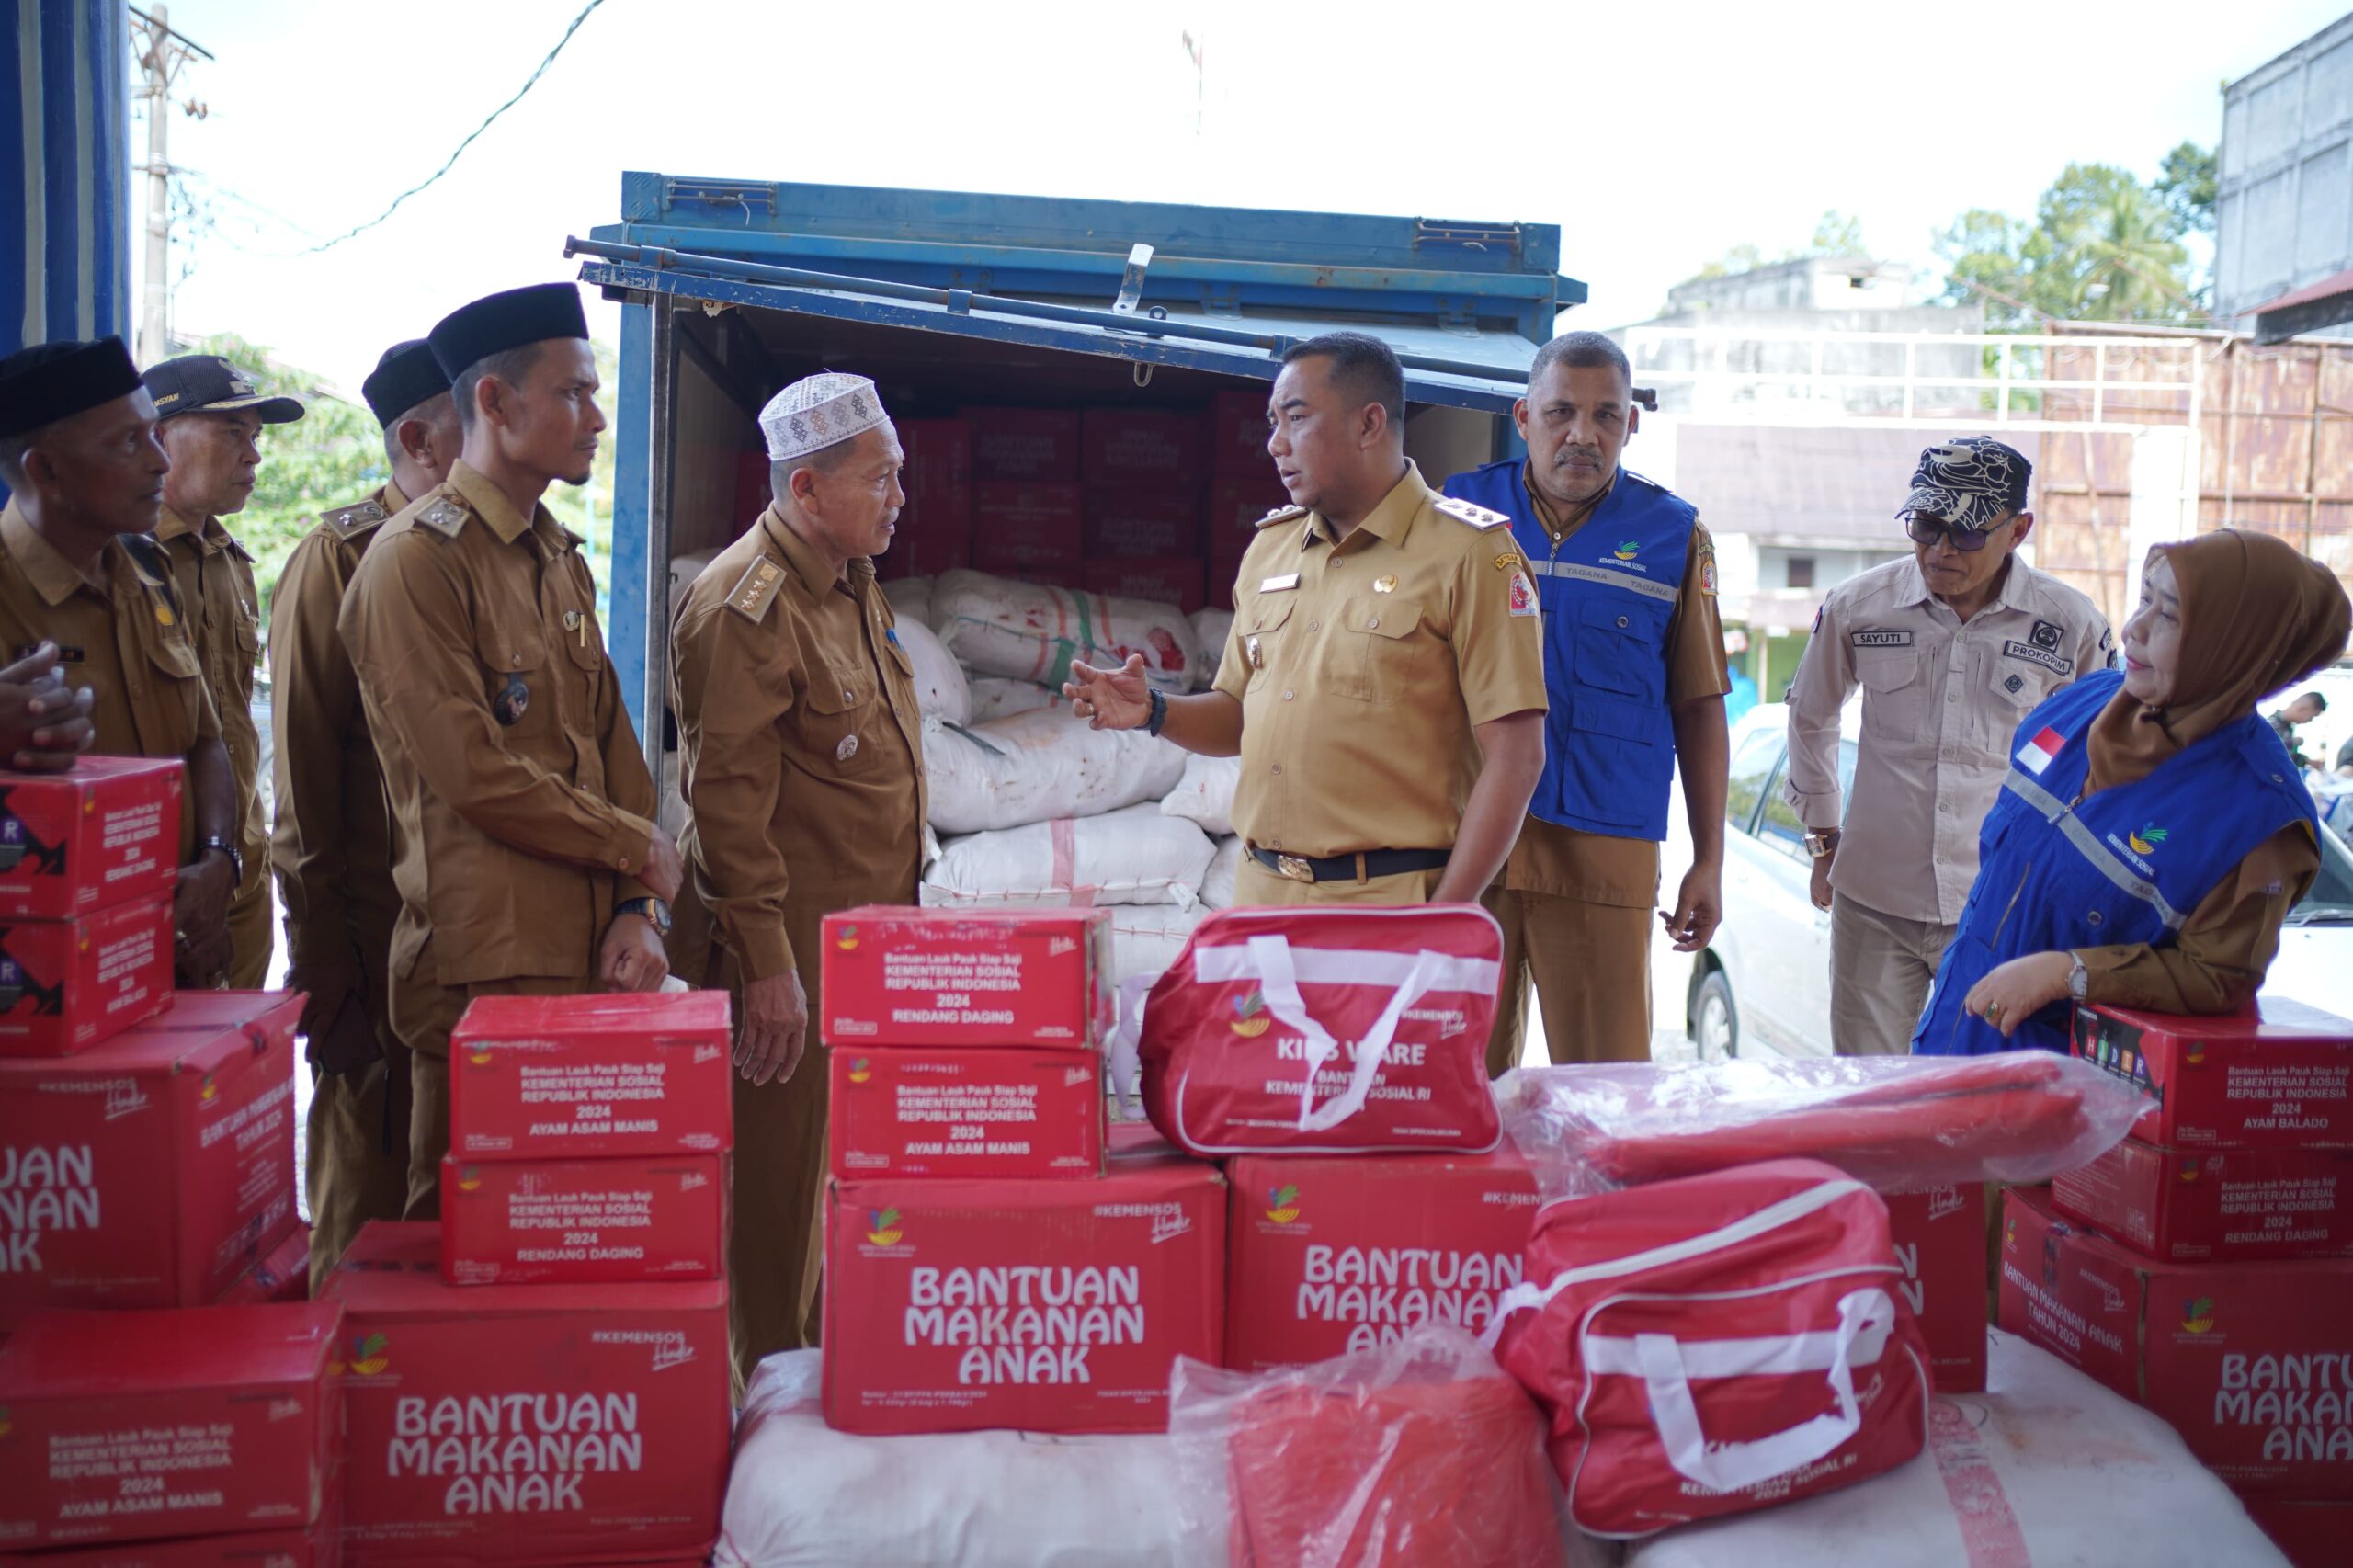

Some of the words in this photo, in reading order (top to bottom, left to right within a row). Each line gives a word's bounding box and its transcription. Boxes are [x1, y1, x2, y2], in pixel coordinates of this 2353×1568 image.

[1632, 563, 1647, 573] SOSIAL
[1566, 567, 1608, 581] TAGANA
[1631, 580, 1668, 597] TAGANA
[1860, 633, 1901, 644] SAYUTI
[2013, 645, 2066, 673] PROKOPIM
[2130, 880, 2170, 919] TAGANA
[885, 966, 973, 977] KEMENTERIAN
[976, 966, 1021, 977] SOSIAL
[885, 978, 949, 990] REPUBLIK
[951, 978, 1021, 990] INDONESIA
[937, 994, 971, 1007] 2024
[892, 1010, 959, 1023] RENDANG
[961, 1010, 1015, 1023] DAGING
[1277, 1038, 1339, 1061] KIS
[1317, 1070, 1386, 1085] BANTN
[2228, 1066, 2263, 1075] Bantuan
[2266, 1066, 2288, 1075] Lauk
[2290, 1066, 2311, 1075] Pauk
[2313, 1066, 2332, 1077] Siap
[2334, 1066, 2350, 1076] Saji
[521, 1077, 615, 1089] KEMENTERIAN
[618, 1075, 664, 1086] SOSIAL
[2228, 1076, 2306, 1087] KEMENTERIAN
[2309, 1076, 2348, 1087] SOSIAL
[521, 1089, 588, 1102] REPUBLIK
[592, 1088, 664, 1100] INDONESIA
[1265, 1081, 1347, 1098] KEMETERI
[1369, 1085, 1415, 1100] SOSIAL
[1417, 1088, 1431, 1100] RI
[2227, 1088, 2281, 1099] REPUBLIK
[2285, 1087, 2347, 1098] INDONESIA
[897, 1097, 987, 1109] KEMENTERIAN
[991, 1097, 1037, 1109] SOSIAL
[2272, 1103, 2301, 1114] 2024
[576, 1106, 611, 1119] 2024
[897, 1109, 963, 1122] REPUBLIK
[965, 1109, 1037, 1122] INDONESIA
[530, 1123, 568, 1136] AYAM
[571, 1121, 609, 1134] ASAM
[614, 1120, 658, 1132] MANIS
[2244, 1118, 2276, 1129] AYAM
[2279, 1118, 2329, 1128] BALADO
[950, 1126, 984, 1140] 2024
[905, 1142, 943, 1155] AYAM
[945, 1142, 984, 1155] ASAM
[987, 1142, 1030, 1155] MANIS
[2222, 1182, 2254, 1191] Bantuan
[2256, 1181, 2280, 1190] Lauk
[2282, 1180, 2304, 1189] Pauk
[2306, 1179, 2323, 1189] Siap
[2324, 1177, 2336, 1187] Saji
[2222, 1191, 2297, 1202] KEMENTERIAN
[2300, 1189, 2336, 1199] SOSIAL
[509, 1205, 601, 1216] KEMENTERIAN
[605, 1204, 651, 1214] SOSIAL
[1093, 1202, 1183, 1218] #KEMENSOS
[2222, 1202, 2273, 1213] REPUBLIK
[2277, 1200, 2335, 1212] INDONESIA
[510, 1217, 576, 1228] REPUBLIK
[579, 1215, 651, 1227] INDONESIA
[2265, 1217, 2292, 1228] 2024
[563, 1233, 598, 1244] 2024
[2225, 1233, 2281, 1243] RENDANG
[2285, 1229, 2328, 1240] DAGING
[517, 1248, 586, 1261] RENDANG
[589, 1247, 644, 1260] DAGING
[1304, 1244, 1523, 1290] BANTUAN
[910, 1265, 1139, 1307] BANTUAN
[1297, 1282, 1515, 1328] MAKANA
[2004, 1261, 2039, 1300] BANTUAN
[2040, 1289, 2086, 1335] MAKANAN
[2088, 1324, 2123, 1354] ANAK
[904, 1304, 1144, 1346] MAKANAN
[2029, 1301, 2057, 1334] TAHUN
[2059, 1325, 2082, 1352] 2024
[592, 1331, 685, 1344] #KEMENSOS
[959, 1346, 1091, 1384] ANAK
[396, 1392, 637, 1436] BANTUAN
[2215, 1390, 2353, 1425] MAKA
[50, 1442, 168, 1462] KEMENTERIAN
[173, 1438, 232, 1453] SOSIAL
[388, 1433, 642, 1476] MAKANAN
[50, 1460, 135, 1479] REPUBLIK
[141, 1452, 232, 1471] INDONESIA
[120, 1477, 165, 1494] 2024
[445, 1473, 584, 1514] ANAK
[59, 1498, 108, 1517] AYAM
[112, 1494, 164, 1513] ASAM
[167, 1492, 223, 1510] MANIS
